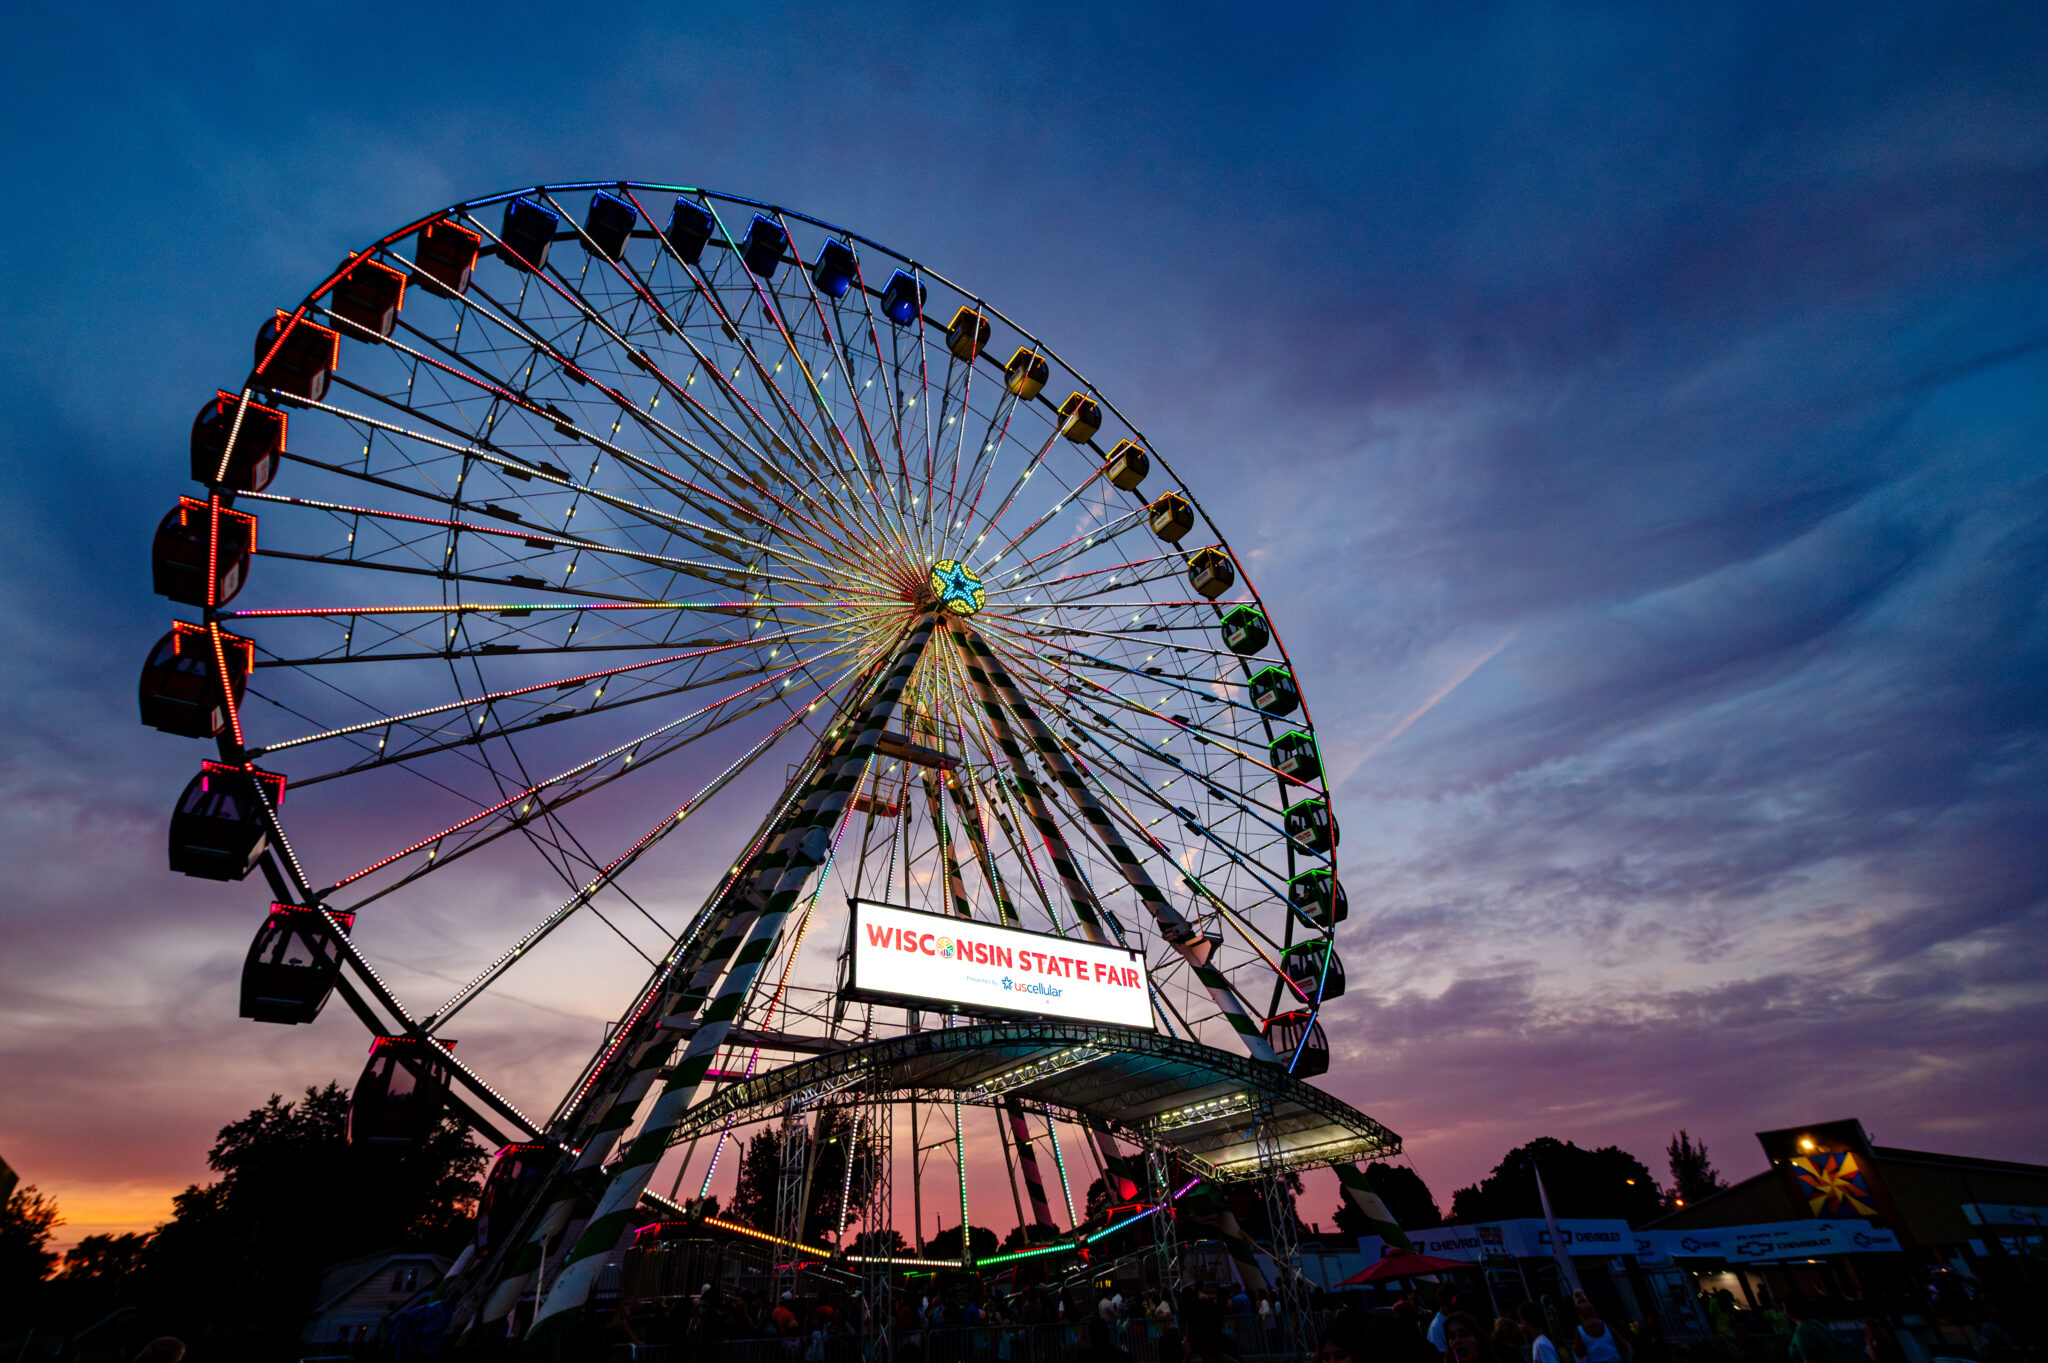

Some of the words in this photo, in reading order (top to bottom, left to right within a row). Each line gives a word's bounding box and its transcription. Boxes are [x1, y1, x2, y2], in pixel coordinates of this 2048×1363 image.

[866, 923, 1013, 969] WISCONSIN
[1019, 950, 1089, 982] STATE
[1094, 963, 1142, 989] FAIR
[1014, 982, 1063, 997] uscellular
[1575, 1232, 1621, 1243] CHEVROLET
